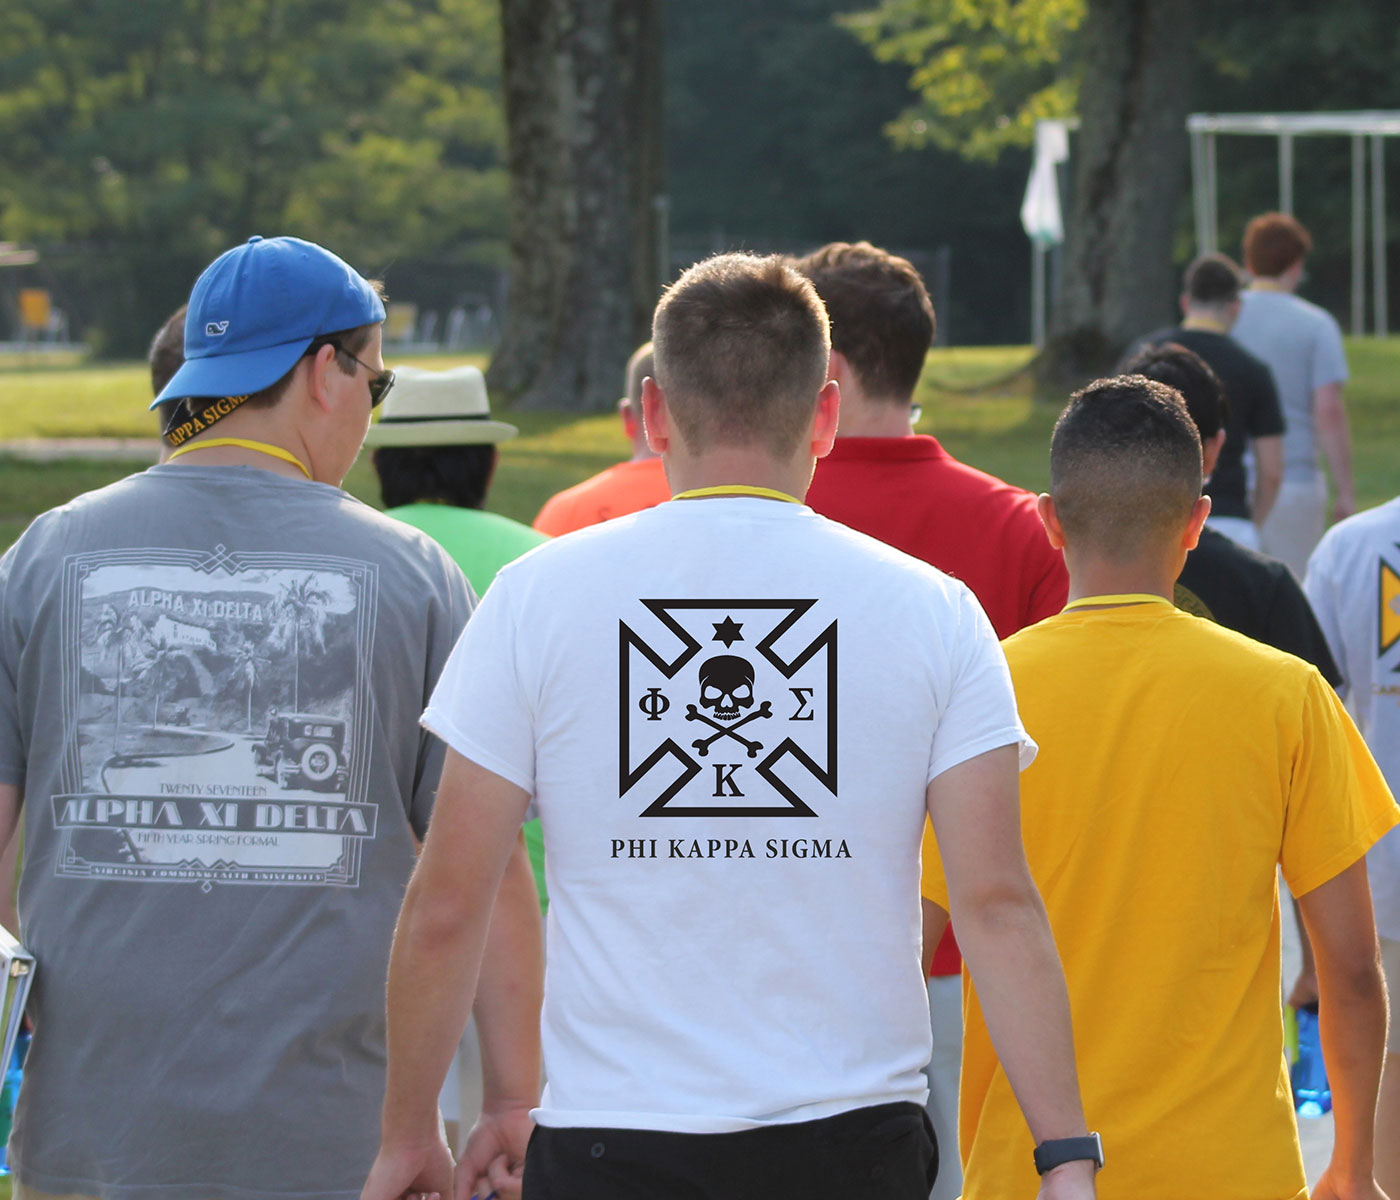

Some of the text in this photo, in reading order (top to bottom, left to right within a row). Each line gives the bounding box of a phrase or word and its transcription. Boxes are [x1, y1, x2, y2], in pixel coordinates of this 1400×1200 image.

[166, 394, 250, 447] APPA SIGM
[128, 590, 264, 622] ALPHA XI DELTA
[160, 783, 267, 796] TWENTY SEVENTEEN
[60, 799, 368, 833] ALPHA XI DELTA
[166, 833, 194, 844] YEAR
[196, 833, 235, 845] SPRING
[235, 835, 280, 847] FORMAL
[610, 838, 853, 859] PHI KAPPA SIGMA
[94, 867, 147, 877] VIRGINIA
